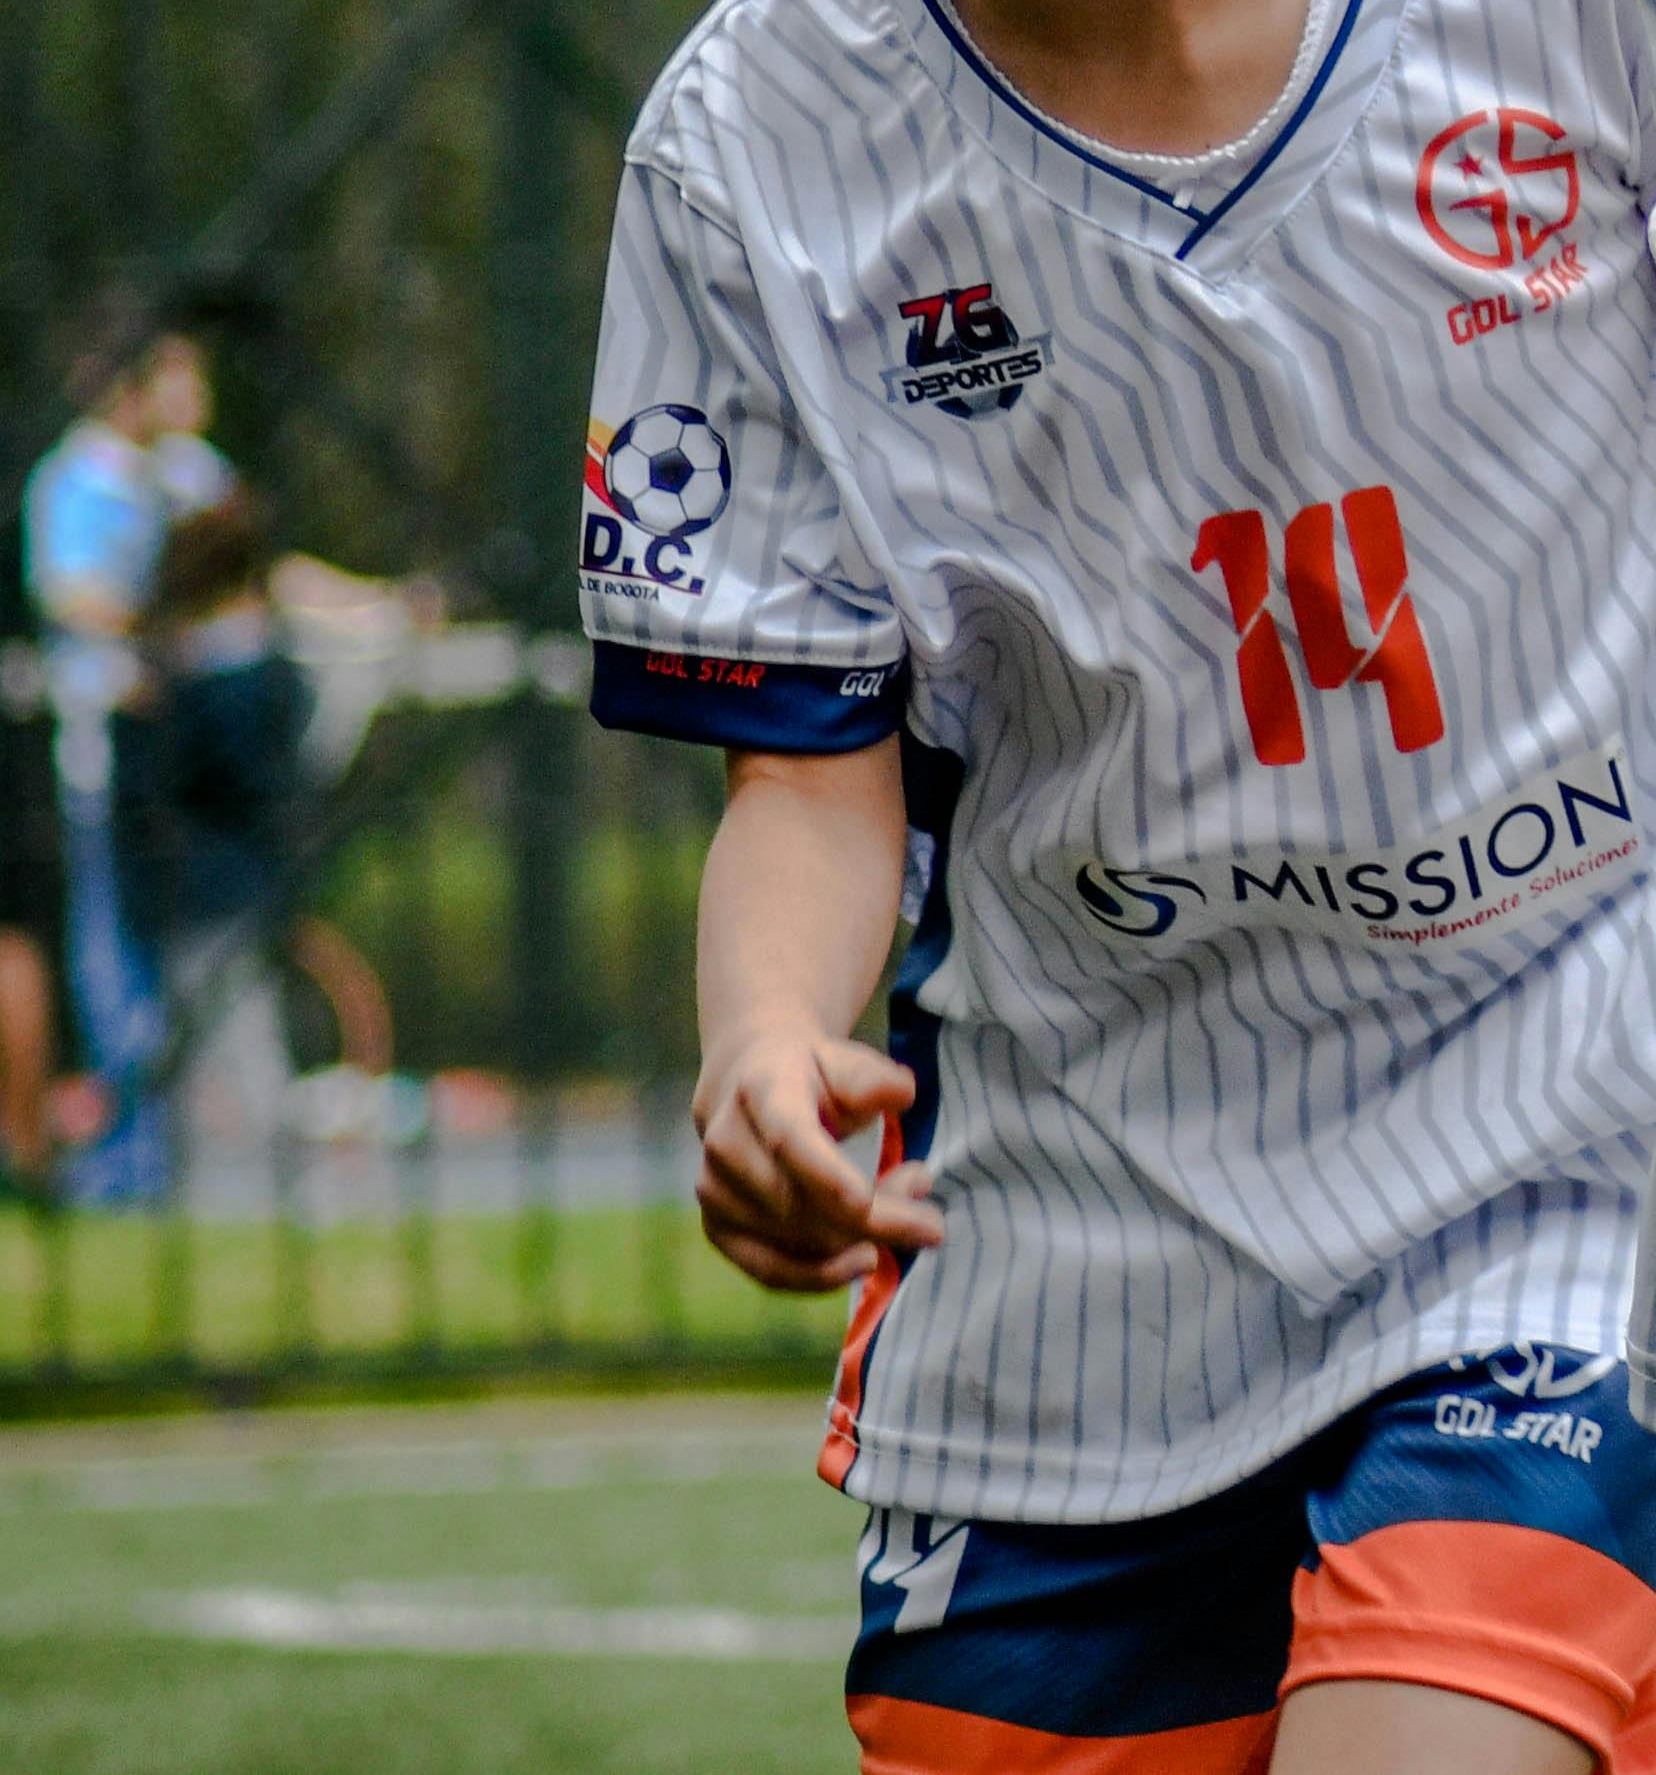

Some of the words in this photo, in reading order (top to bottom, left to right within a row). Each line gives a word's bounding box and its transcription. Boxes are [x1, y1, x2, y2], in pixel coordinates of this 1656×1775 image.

[1446, 293, 1522, 346] GOL
[1523, 242, 1589, 313] STAR
[901, 349, 1043, 405] DEPORTES
[697, 659, 767, 689] STAR
[1191, 485, 1445, 767] 14
[1230, 757, 1633, 921] MISSION
[1366, 893, 1522, 947] Simplemente
[1529, 833, 1641, 902] Soluciones
[1434, 1393, 1497, 1439] GOL
[1502, 1411, 1603, 1464] STAR
